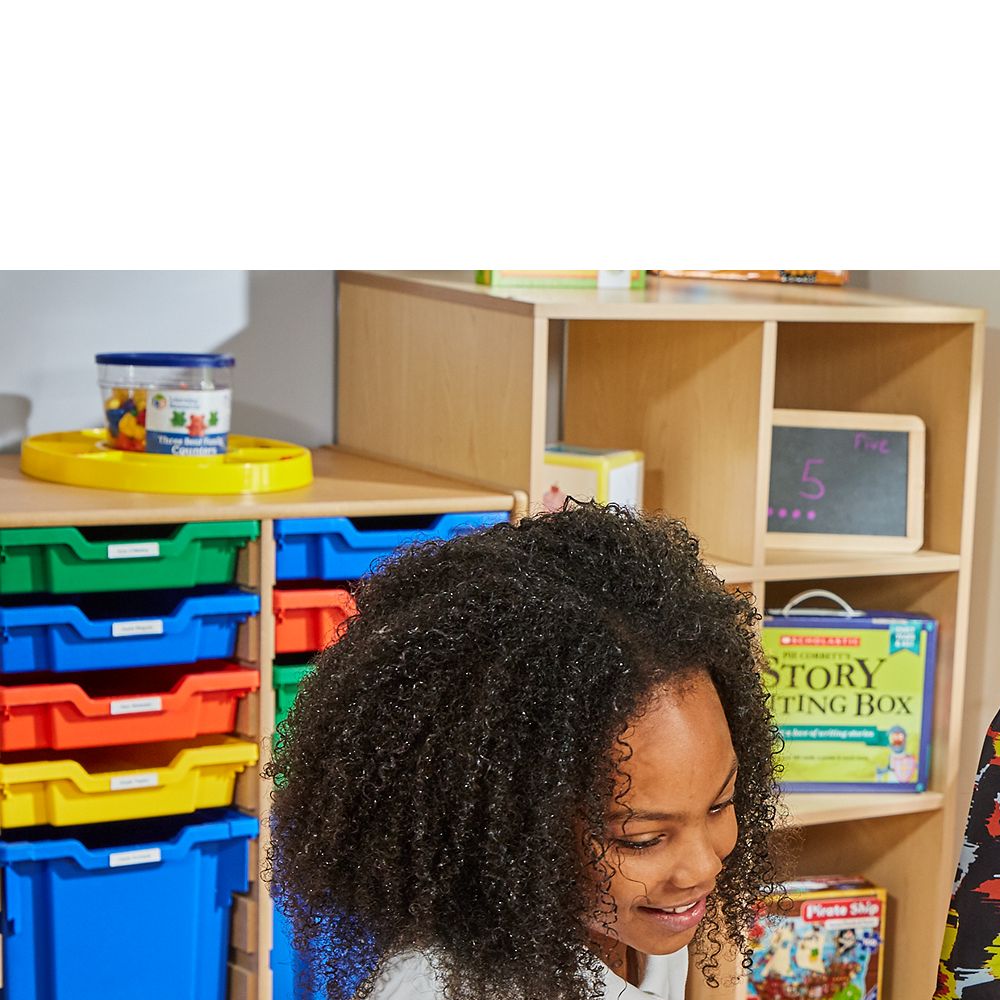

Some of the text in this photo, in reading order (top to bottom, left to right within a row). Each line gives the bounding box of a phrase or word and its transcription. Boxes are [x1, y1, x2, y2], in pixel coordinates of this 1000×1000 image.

[799, 458, 826, 500] 5
[764, 655, 886, 691] STORY
[855, 692, 913, 717] BOX
[806, 902, 880, 919] Pirate Ship
